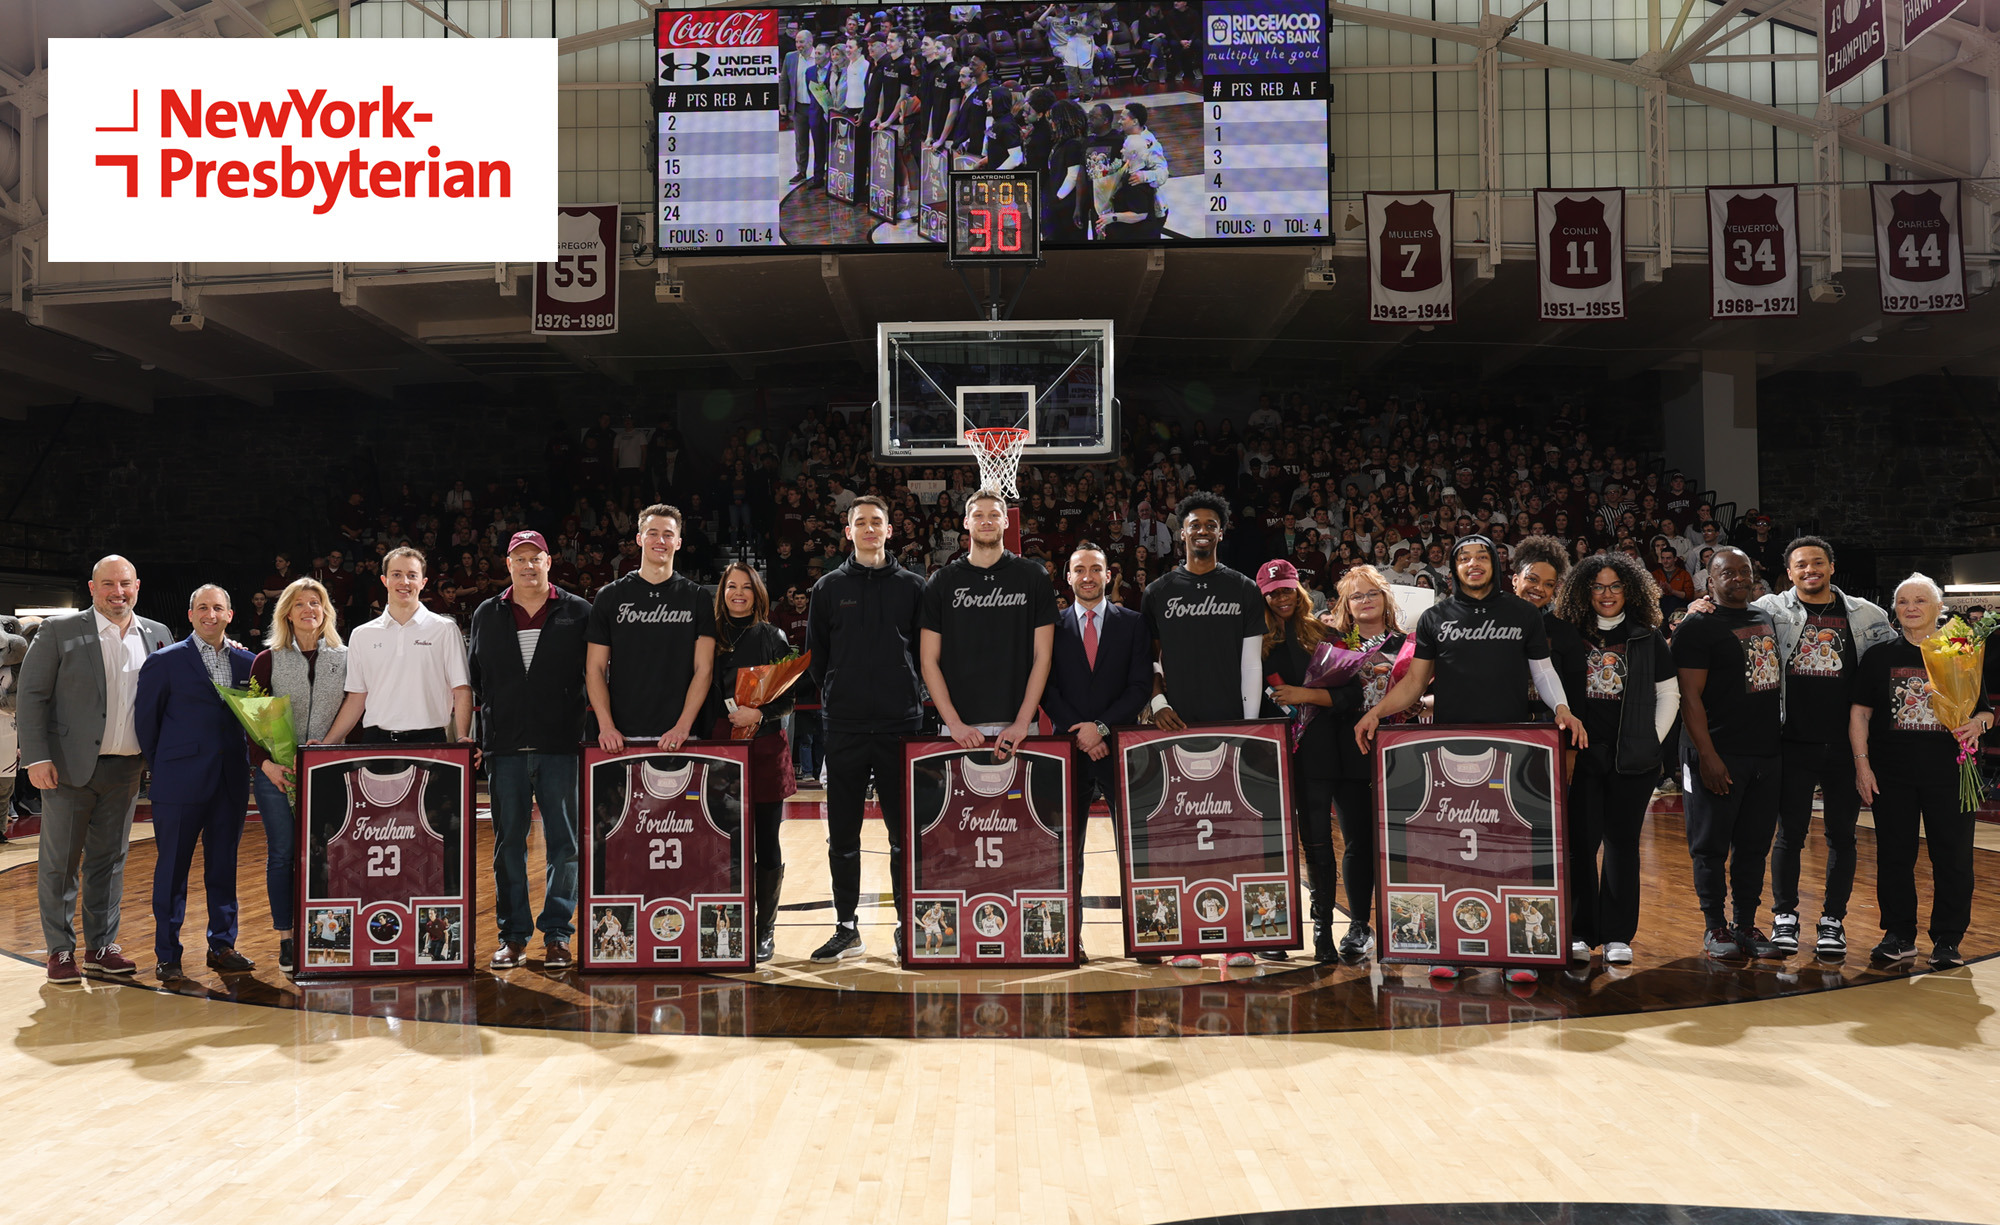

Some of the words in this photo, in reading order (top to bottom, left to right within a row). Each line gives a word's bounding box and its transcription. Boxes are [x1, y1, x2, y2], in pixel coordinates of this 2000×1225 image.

[668, 11, 771, 46] Coca-Cola
[1232, 13, 1320, 31] RIDGEWOOD
[1232, 31, 1285, 45] SAVINGS
[1286, 30, 1320, 44] BANK
[1208, 47, 1259, 66] multiply
[1265, 46, 1285, 59] the
[1288, 46, 1320, 65] good
[1827, 21, 1880, 75] CHAMPIONS
[718, 55, 772, 65] UNDER
[712, 67, 777, 77] ARMOUR
[1231, 82, 1253, 97] PTS
[1260, 82, 1284, 96] REB
[1292, 82, 1300, 96] A
[1310, 81, 1317, 95] F
[687, 93, 707, 107] PTS
[714, 92, 736, 107] REB
[745, 92, 753, 106] A
[763, 91, 770, 105] F
[1213, 105, 1222, 120] 0
[667, 116, 676, 131] 2
[1215, 126, 1221, 141] 1
[667, 137, 676, 152] 3
[1213, 149, 1222, 165] 3
[664, 159, 680, 175] 15
[1213, 173, 1222, 188] 4
[664, 182, 680, 198] 23
[977, 182, 1028, 205] 7:07
[1210, 196, 1227, 211] 20
[663, 205, 680, 221] 24
[969, 208, 1021, 252] 30
[1216, 220, 1256, 234] FOULS:
[1263, 219, 1271, 233] 0
[1284, 219, 1308, 233] TOL:
[1313, 219, 1322, 232] 4
[1562, 227, 1599, 236] CONLIN
[1727, 224, 1779, 233] YELVERTON
[1896, 219, 1941, 229] CHARLES
[669, 229, 708, 243] FOULS:
[716, 229, 723, 242] 0
[738, 228, 763, 243] TOL:
[764, 228, 773, 242] 4
[1388, 229, 1434, 239] MULLENS
[1566, 241, 1598, 275] 11
[1732, 238, 1776, 272] 34
[1898, 233, 1942, 268] 44
[1400, 244, 1421, 278] 7
[555, 254, 597, 288] 55
[1544, 301, 1621, 316] 1951-1955
[1717, 297, 1796, 314] 1968-1971
[1884, 293, 1963, 310] 1970-1973
[1373, 303, 1450, 319] 1942-1944
[537, 313, 614, 328] 1976-1980
[1268, 566, 1279, 579] F
[951, 587, 1028, 610] Fordham
[1164, 595, 1242, 619] Fordham
[616, 602, 694, 625] Fordham
[1437, 619, 1523, 643] Fordham
[1174, 791, 1233, 816] Fordham
[1436, 797, 1500, 824] Fordham
[635, 809, 694, 834] Fordham
[959, 806, 1018, 833] Fordham
[352, 816, 416, 841] Fordham
[1196, 819, 1215, 850] 2
[974, 837, 1004, 868] 15
[1459, 828, 1478, 861] 3
[367, 845, 401, 877] 23
[649, 838, 682, 870] 23
